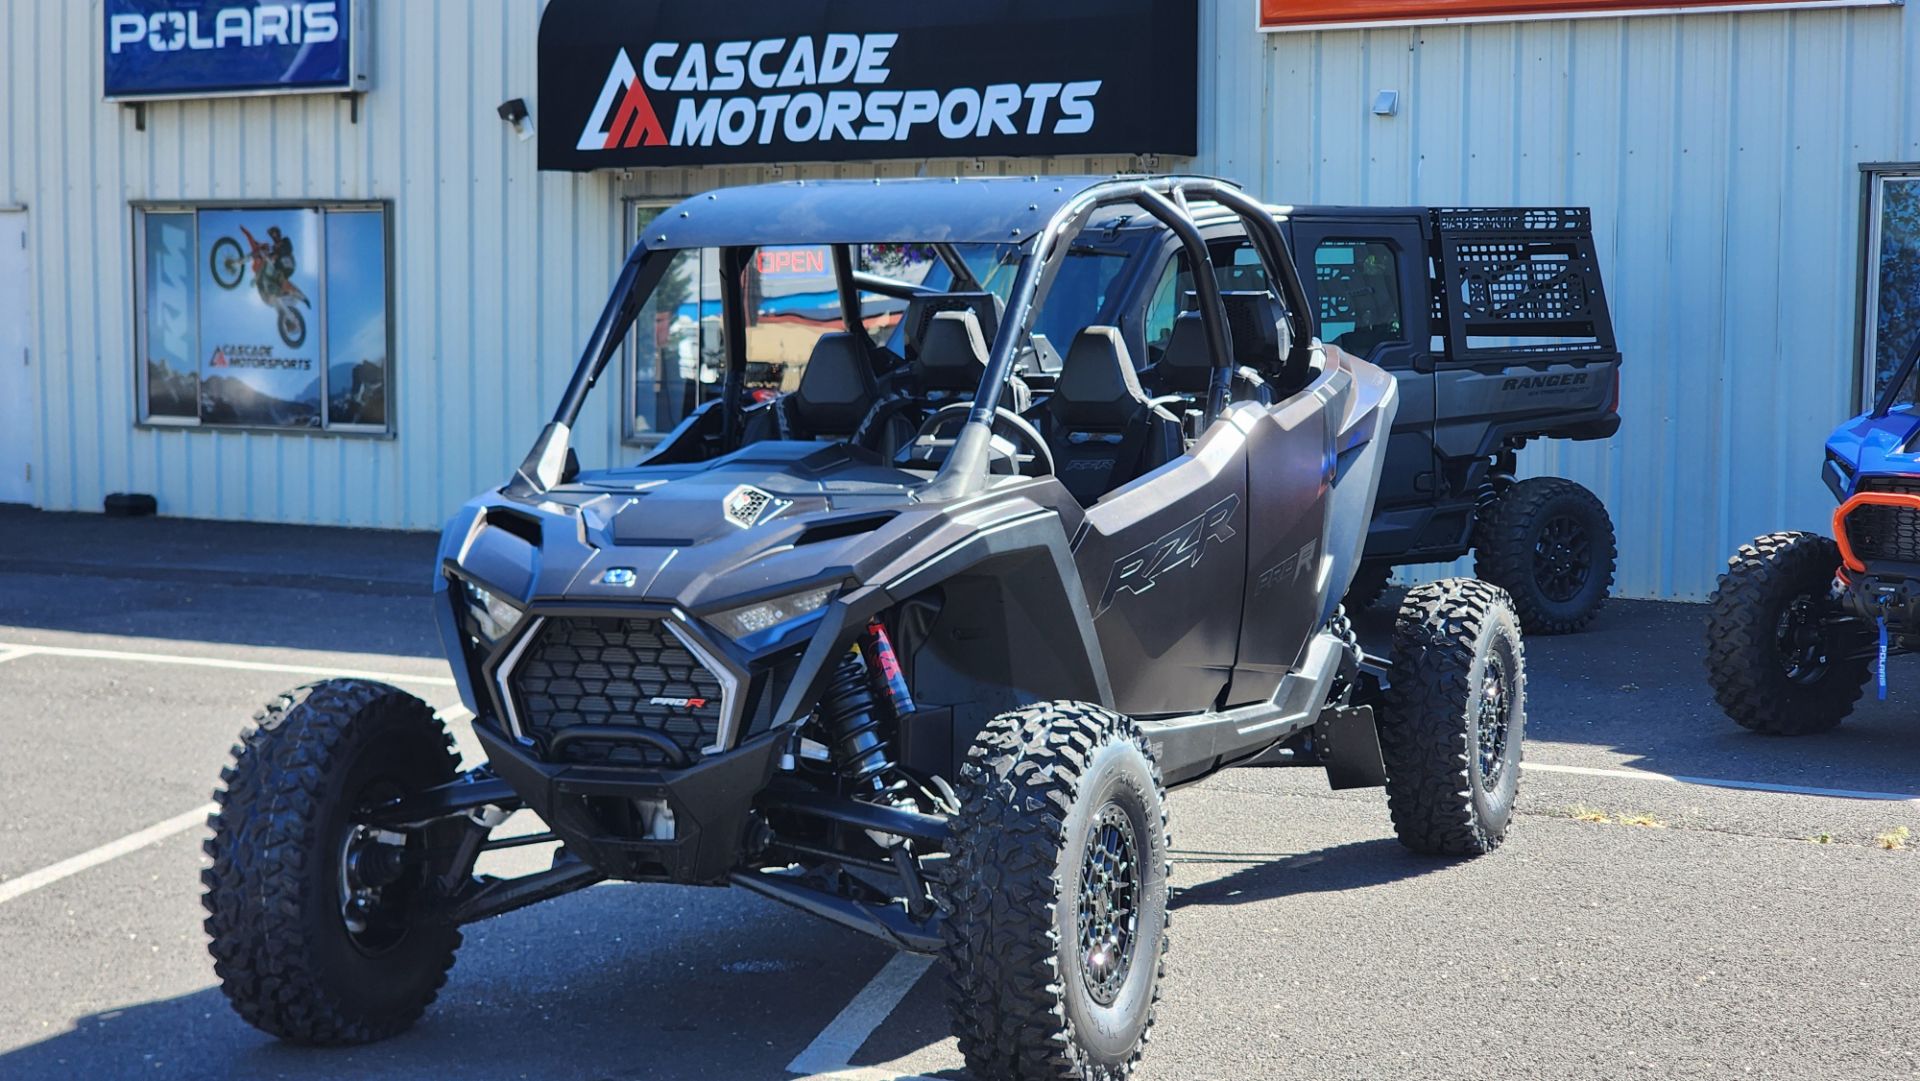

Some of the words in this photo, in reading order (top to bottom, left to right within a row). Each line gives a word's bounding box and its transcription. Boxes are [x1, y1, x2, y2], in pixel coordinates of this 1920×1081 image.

[111, 2, 339, 54] POLARIS
[643, 33, 899, 91] CASCADE
[669, 80, 1102, 147] MOTORSPORTS
[757, 250, 824, 273] OPEN
[223, 344, 273, 357] CASCADE
[229, 357, 312, 371] MOTORSPORTS
[1502, 372, 1589, 391] RANGER
[1092, 492, 1241, 622] RZR
[1879, 645, 1888, 687] POLARIS
